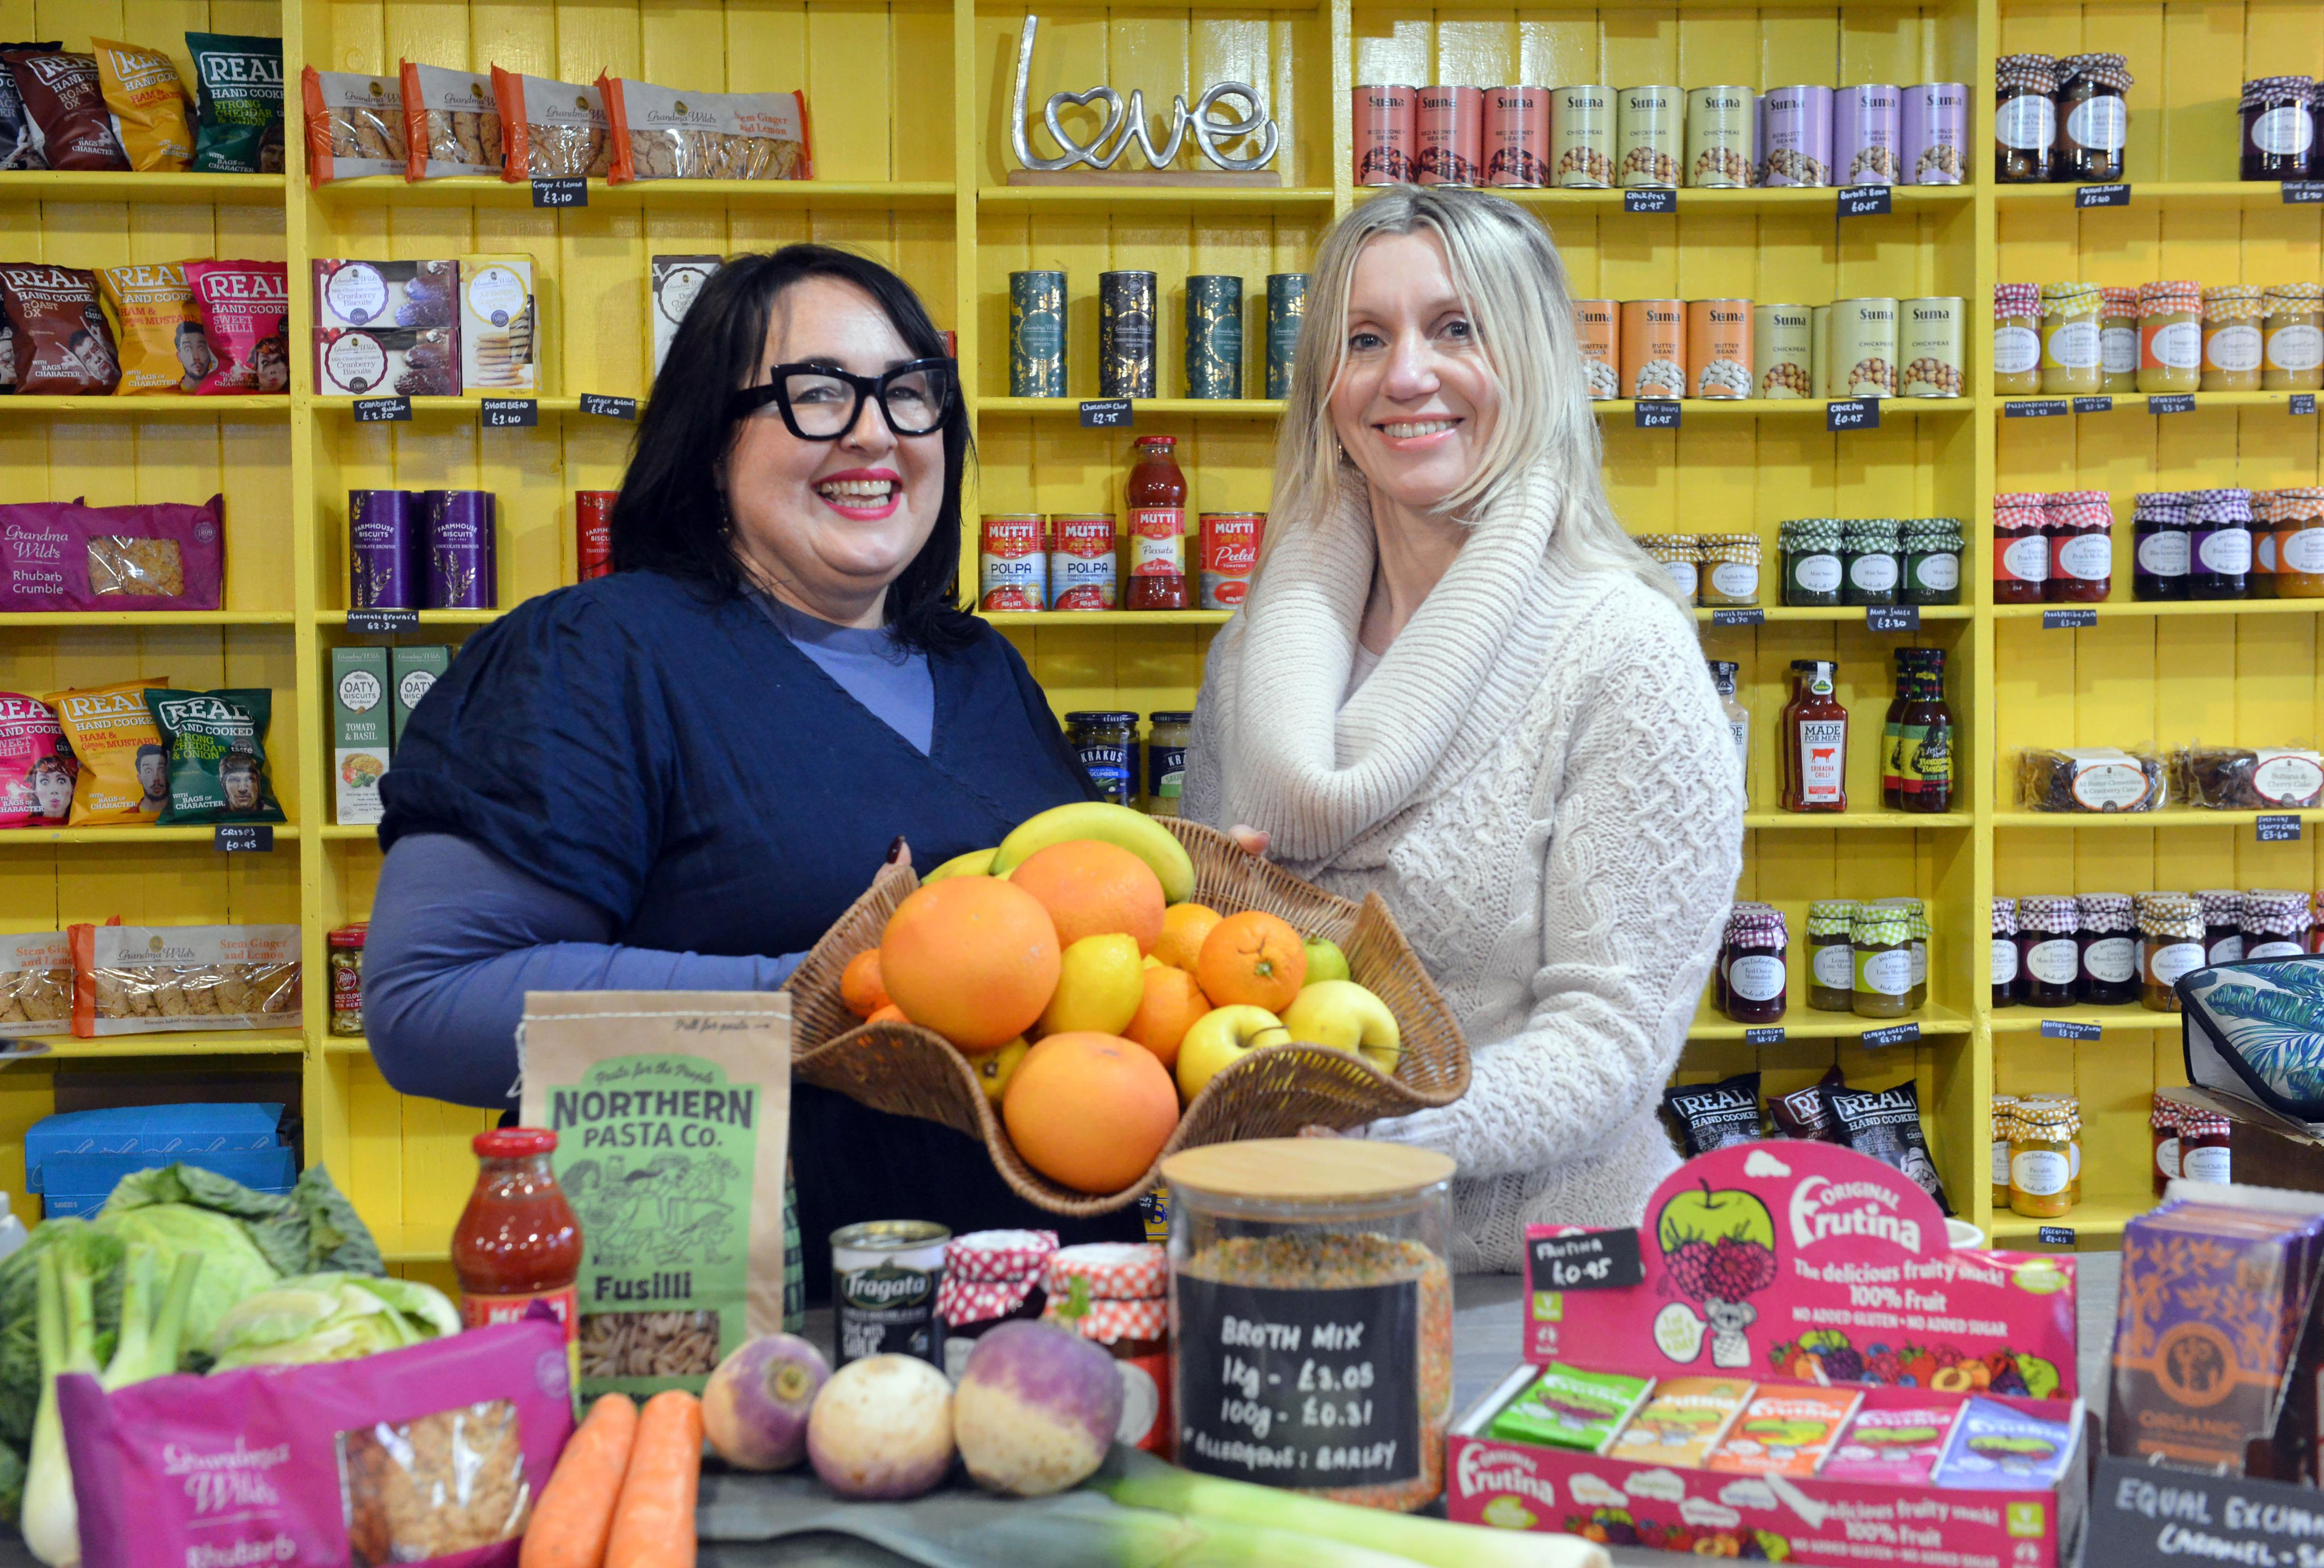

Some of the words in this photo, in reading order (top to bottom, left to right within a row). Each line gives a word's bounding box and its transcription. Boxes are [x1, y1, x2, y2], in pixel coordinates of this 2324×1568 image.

[211, 88, 246, 99] HAND
[1012, 14, 1279, 170] love
[64, 98, 81, 111] OX
[214, 101, 261, 109] STRONG
[1369, 96, 1404, 107] Suma
[1423, 97, 1456, 108] Suma
[1497, 97, 1534, 108] Suma
[1567, 96, 1603, 108] Suma
[1631, 97, 1666, 109] Suma
[1705, 96, 1740, 108] Suma
[1770, 99, 1804, 111] Suma
[1861, 96, 1895, 108] Suma
[1927, 94, 1962, 106] Suma
[216, 108, 272, 117] CHEDDAR
[647, 111, 688, 122] Grandma
[757, 112, 787, 125] Ginger
[757, 124, 787, 135] Lemon
[544, 193, 572, 203] £3.10
[6, 270, 91, 288] REAL
[210, 277, 288, 297] REAL
[18, 292, 51, 302] HAND
[22, 300, 58, 311] ROAST
[121, 307, 145, 316] HAM
[212, 305, 242, 314] HAND
[24, 309, 41, 318] OX
[146, 314, 197, 324] MUSTARD
[1646, 310, 1680, 322] Suma
[1710, 310, 1745, 322] Suma
[1860, 308, 1893, 320] Suma
[1913, 308, 1949, 320] Suma
[214, 316, 253, 325] SWEET
[215, 324, 253, 332] CHILLI
[492, 413, 521, 425] £2.40
[1141, 514, 1175, 523] MUTTI
[4, 525, 68, 542] Grandma
[354, 523, 395, 534] FARMHOUSE
[437, 524, 478, 534] FARMHOUSE
[989, 526, 1033, 537] MUTTI
[1066, 526, 1109, 537] MUTTI
[1215, 524, 1253, 533] MUTTI
[13, 542, 60, 559] Wild's
[1143, 545, 1173, 554] Passata
[1215, 546, 1256, 566] Peeled
[991, 563, 1032, 574] POLPA
[1068, 563, 1108, 573] POLPA
[13, 570, 63, 583] Rhubarb
[13, 584, 63, 595] Crumble
[345, 681, 374, 693] OATY
[73, 693, 147, 716] REAL
[168, 701, 251, 723] REAL
[76, 721, 111, 731] HAND
[206, 726, 254, 736] COOKED
[1805, 726, 1840, 735] MADE
[79, 733, 107, 741] HAM
[354, 732, 377, 740] BASIL
[106, 737, 159, 748] MUSTARD
[173, 741, 227, 753] CHEDDAR
[183, 750, 220, 760] ONION
[1081, 750, 1123, 763] KRAKUS
[226, 840, 256, 851] £0.95
[220, 939, 246, 949] Stem
[247, 938, 287, 951] Ginger
[17, 946, 46, 957] Stem
[117, 949, 161, 960] Grandma
[162, 948, 195, 959] Wild's
[224, 949, 244, 960] and
[247, 948, 285, 960] Lemon
[1679, 1089, 1753, 1113] REAL
[1844, 1088, 1913, 1114] REAL
[553, 1090, 753, 1131] NORTHERN
[1691, 1116, 1721, 1128] HAND
[1723, 1112, 1759, 1122] COOKED
[1849, 1118, 1879, 1129] HAND
[1880, 1114, 1919, 1124] COOKED
[1717, 1123, 1740, 1132] SALT
[1852, 1129, 1872, 1139] SEA
[1874, 1126, 1895, 1134] SALT
[583, 1123, 673, 1148] PASTA
[1865, 1134, 1896, 1144] BLACK
[1820, 1183, 1900, 1209] ORIGINAL
[1789, 1176, 1920, 1253] Frutina
[1794, 1258, 1819, 1278] The
[1822, 1260, 1900, 1283] delicious
[1903, 1260, 1956, 1283] fruity
[1958, 1265, 2004, 1288] snack!
[595, 1272, 692, 1301] Fusilli
[849, 1275, 925, 1301] Fragata
[1849, 1286, 1902, 1308] 100%
[1905, 1291, 1947, 1312] Fruit
[1793, 1307, 1810, 1320] NO
[1813, 1308, 1851, 1323] ADDED
[1853, 1311, 1899, 1328] GLUTEN
[1907, 1315, 1924, 1330] NO
[1927, 1316, 1966, 1334] ADDED
[1969, 1321, 2007, 1337] SUGAR
[1221, 1315, 1301, 1351] BROTH
[1312, 1321, 1364, 1350] MIX
[1223, 1355, 1260, 1398] 1kg
[1297, 1358, 1374, 1391] £3.05
[1221, 1398, 1272, 1438] 100g
[1302, 1395, 1372, 1427] £0.31
[2139, 1410, 2242, 1438] ORGANIC
[1316, 1440, 1397, 1471] BARLEY
[1458, 1443, 1555, 1507] Frutina
[2116, 1477, 2212, 1524] EQUAL
[1897, 1499, 1949, 1521] fruity
[1845, 1522, 1897, 1544] 100%
[1900, 1526, 1942, 1547] Fruit
